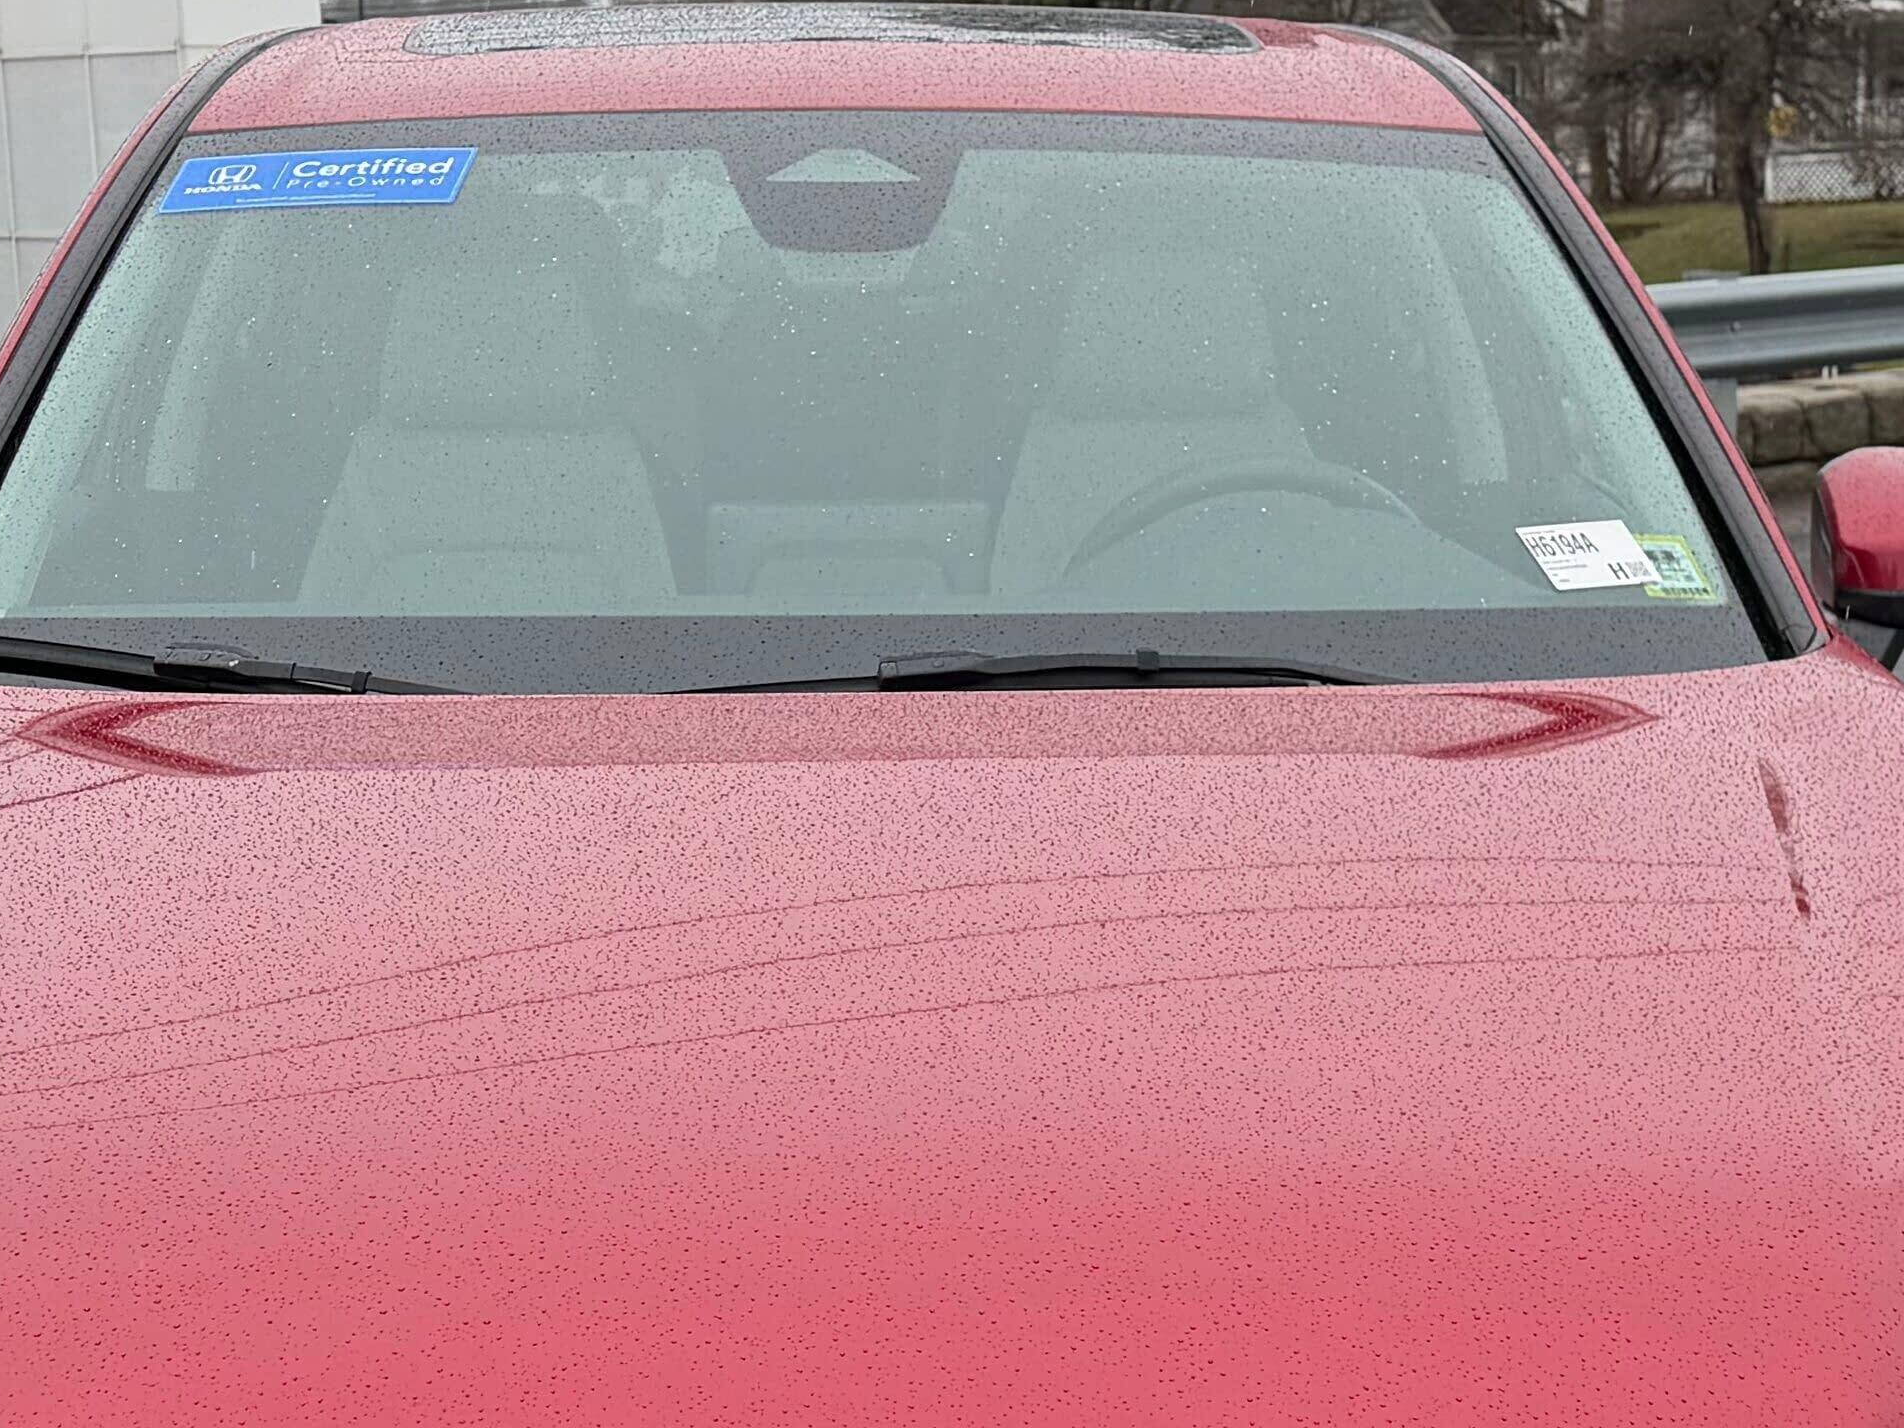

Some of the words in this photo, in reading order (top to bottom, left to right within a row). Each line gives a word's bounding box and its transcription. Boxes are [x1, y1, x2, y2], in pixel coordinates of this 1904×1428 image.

[292, 156, 455, 178] Certified
[184, 183, 263, 195] HONDA
[286, 175, 445, 190] Pre-Owned
[1525, 532, 1600, 557] H6194A
[1608, 562, 1630, 580] H
